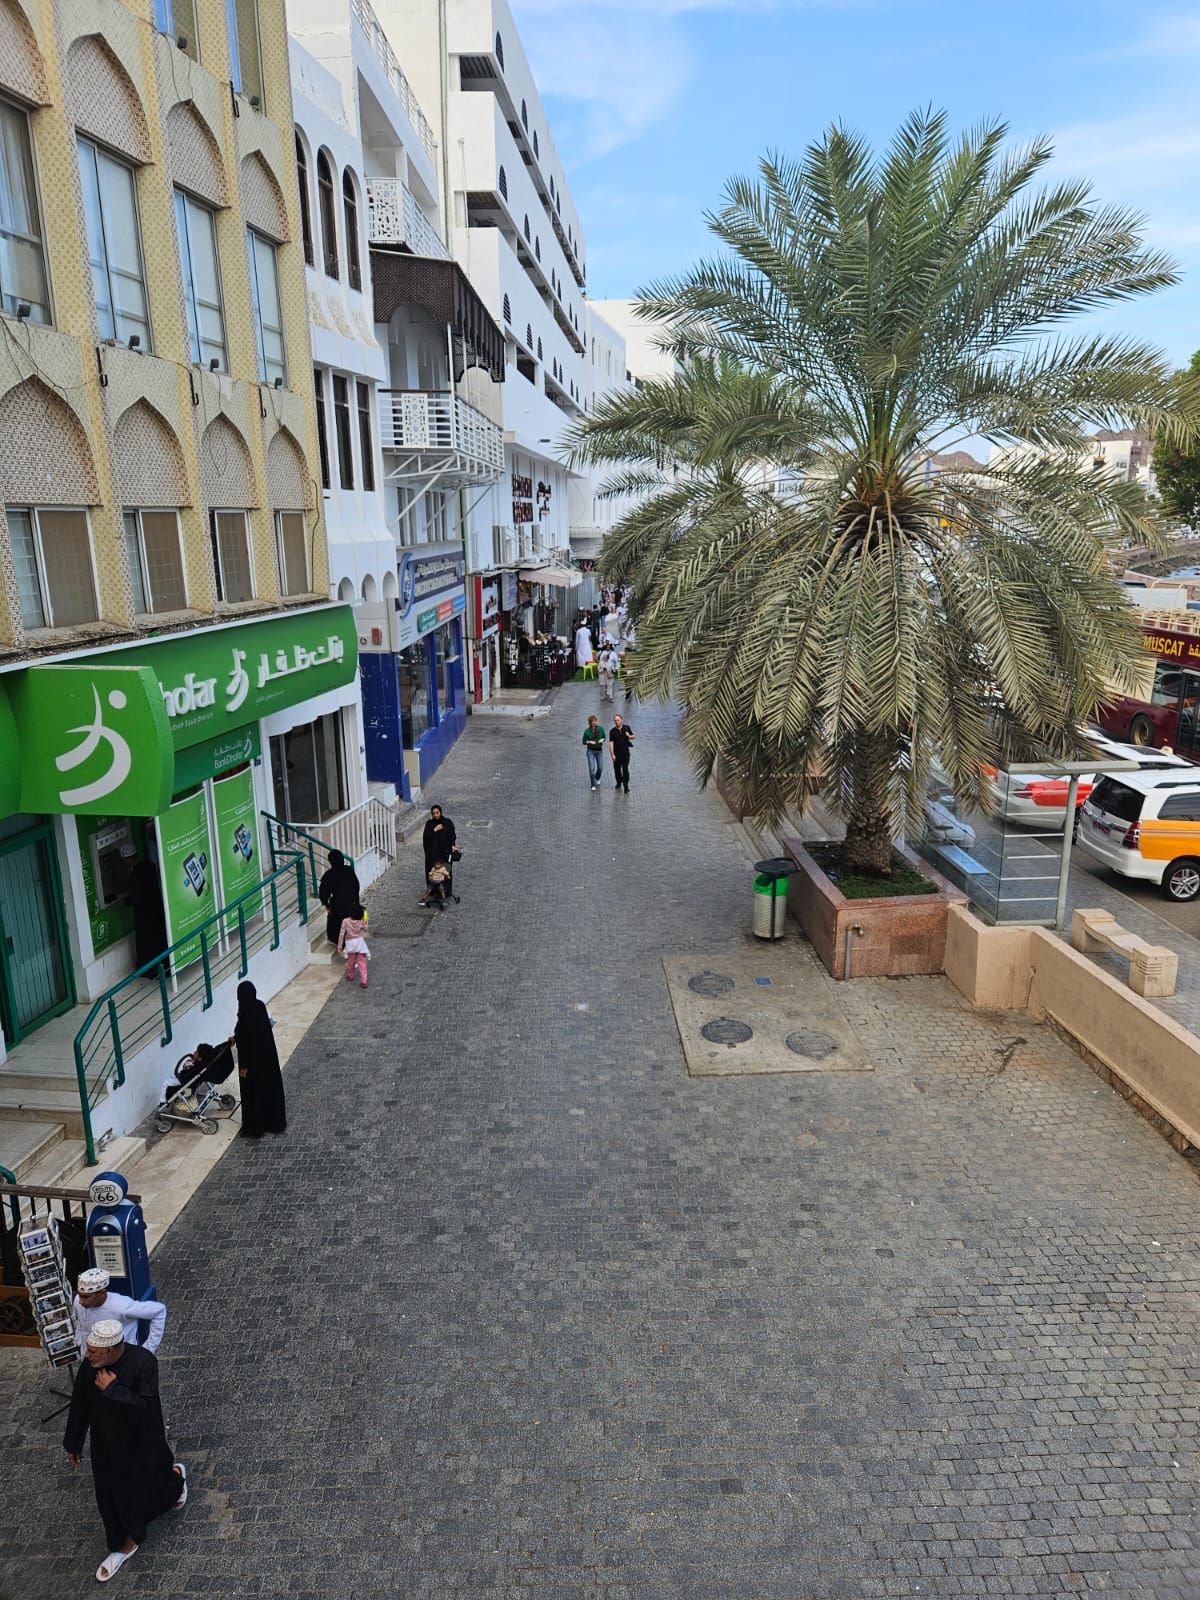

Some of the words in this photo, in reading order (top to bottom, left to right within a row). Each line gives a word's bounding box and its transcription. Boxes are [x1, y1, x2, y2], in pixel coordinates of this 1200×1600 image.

[1144, 635, 1184, 656] MUSCAT
[159, 673, 217, 717] hofar
[98, 1192, 114, 1202] 66
